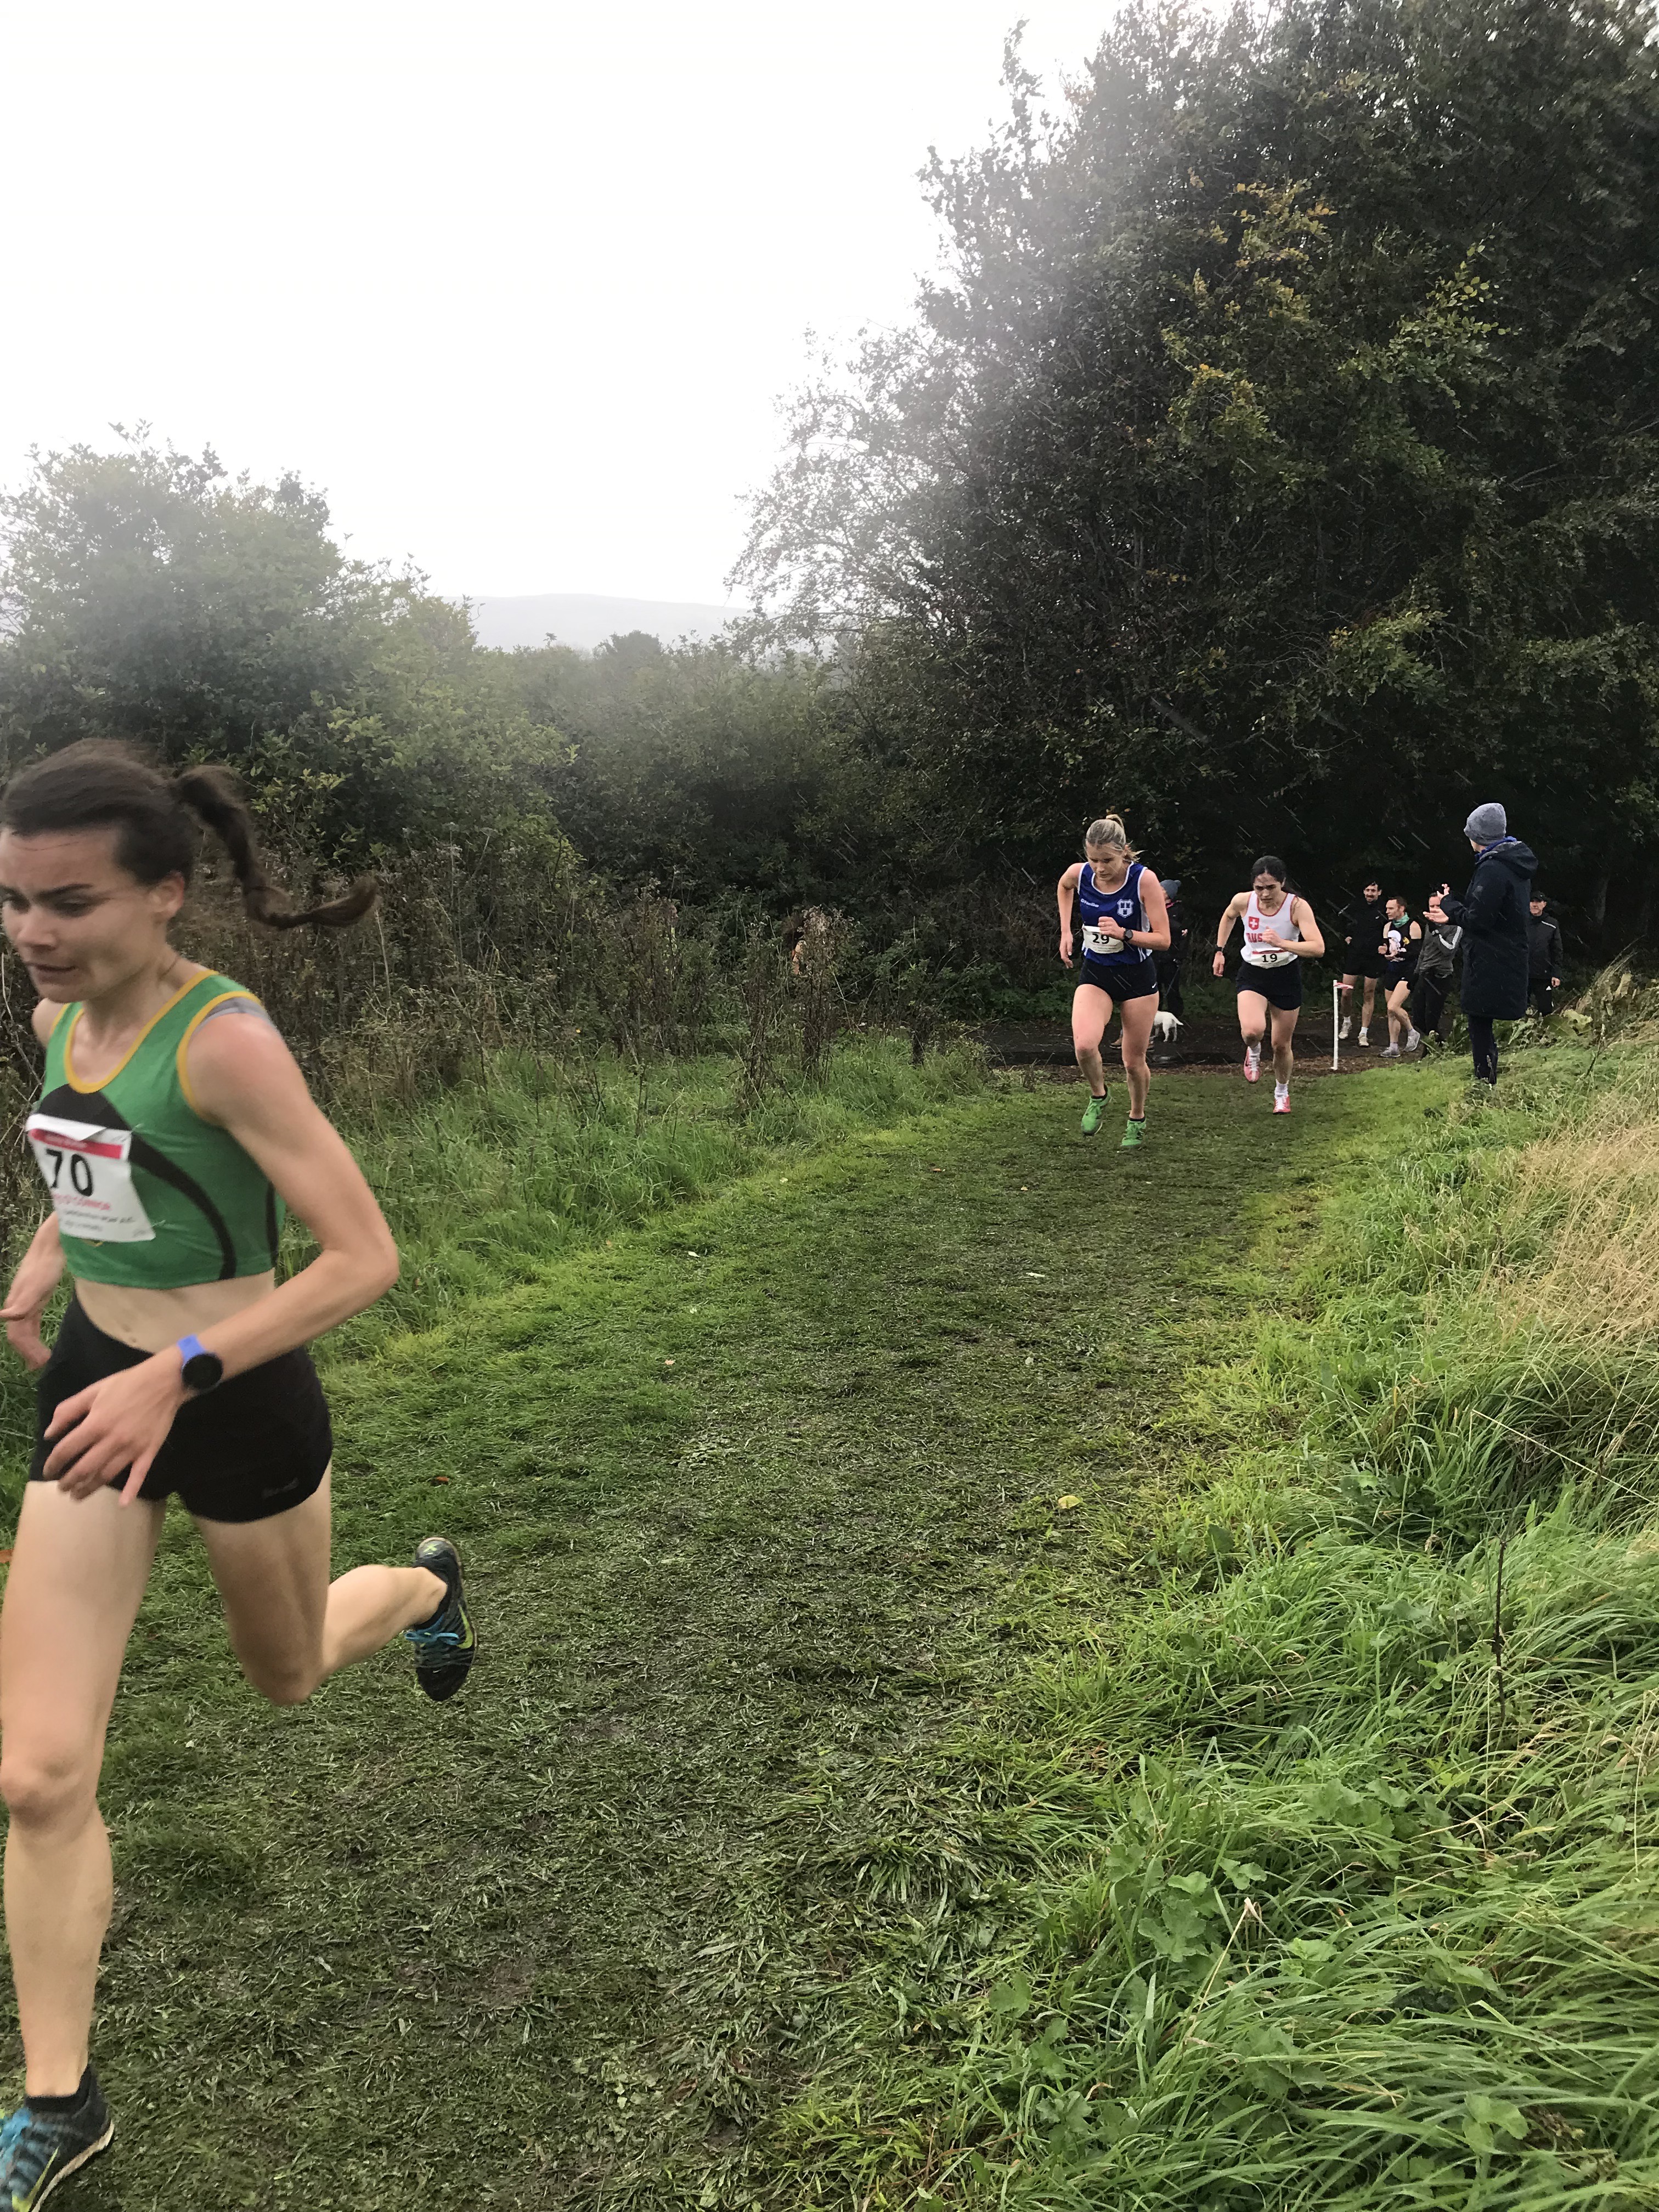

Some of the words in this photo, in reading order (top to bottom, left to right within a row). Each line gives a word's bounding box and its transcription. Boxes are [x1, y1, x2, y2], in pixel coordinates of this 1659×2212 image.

[1092, 933, 1109, 944] 29
[1262, 953, 1278, 963] 19
[44, 1148, 94, 1197] 70
